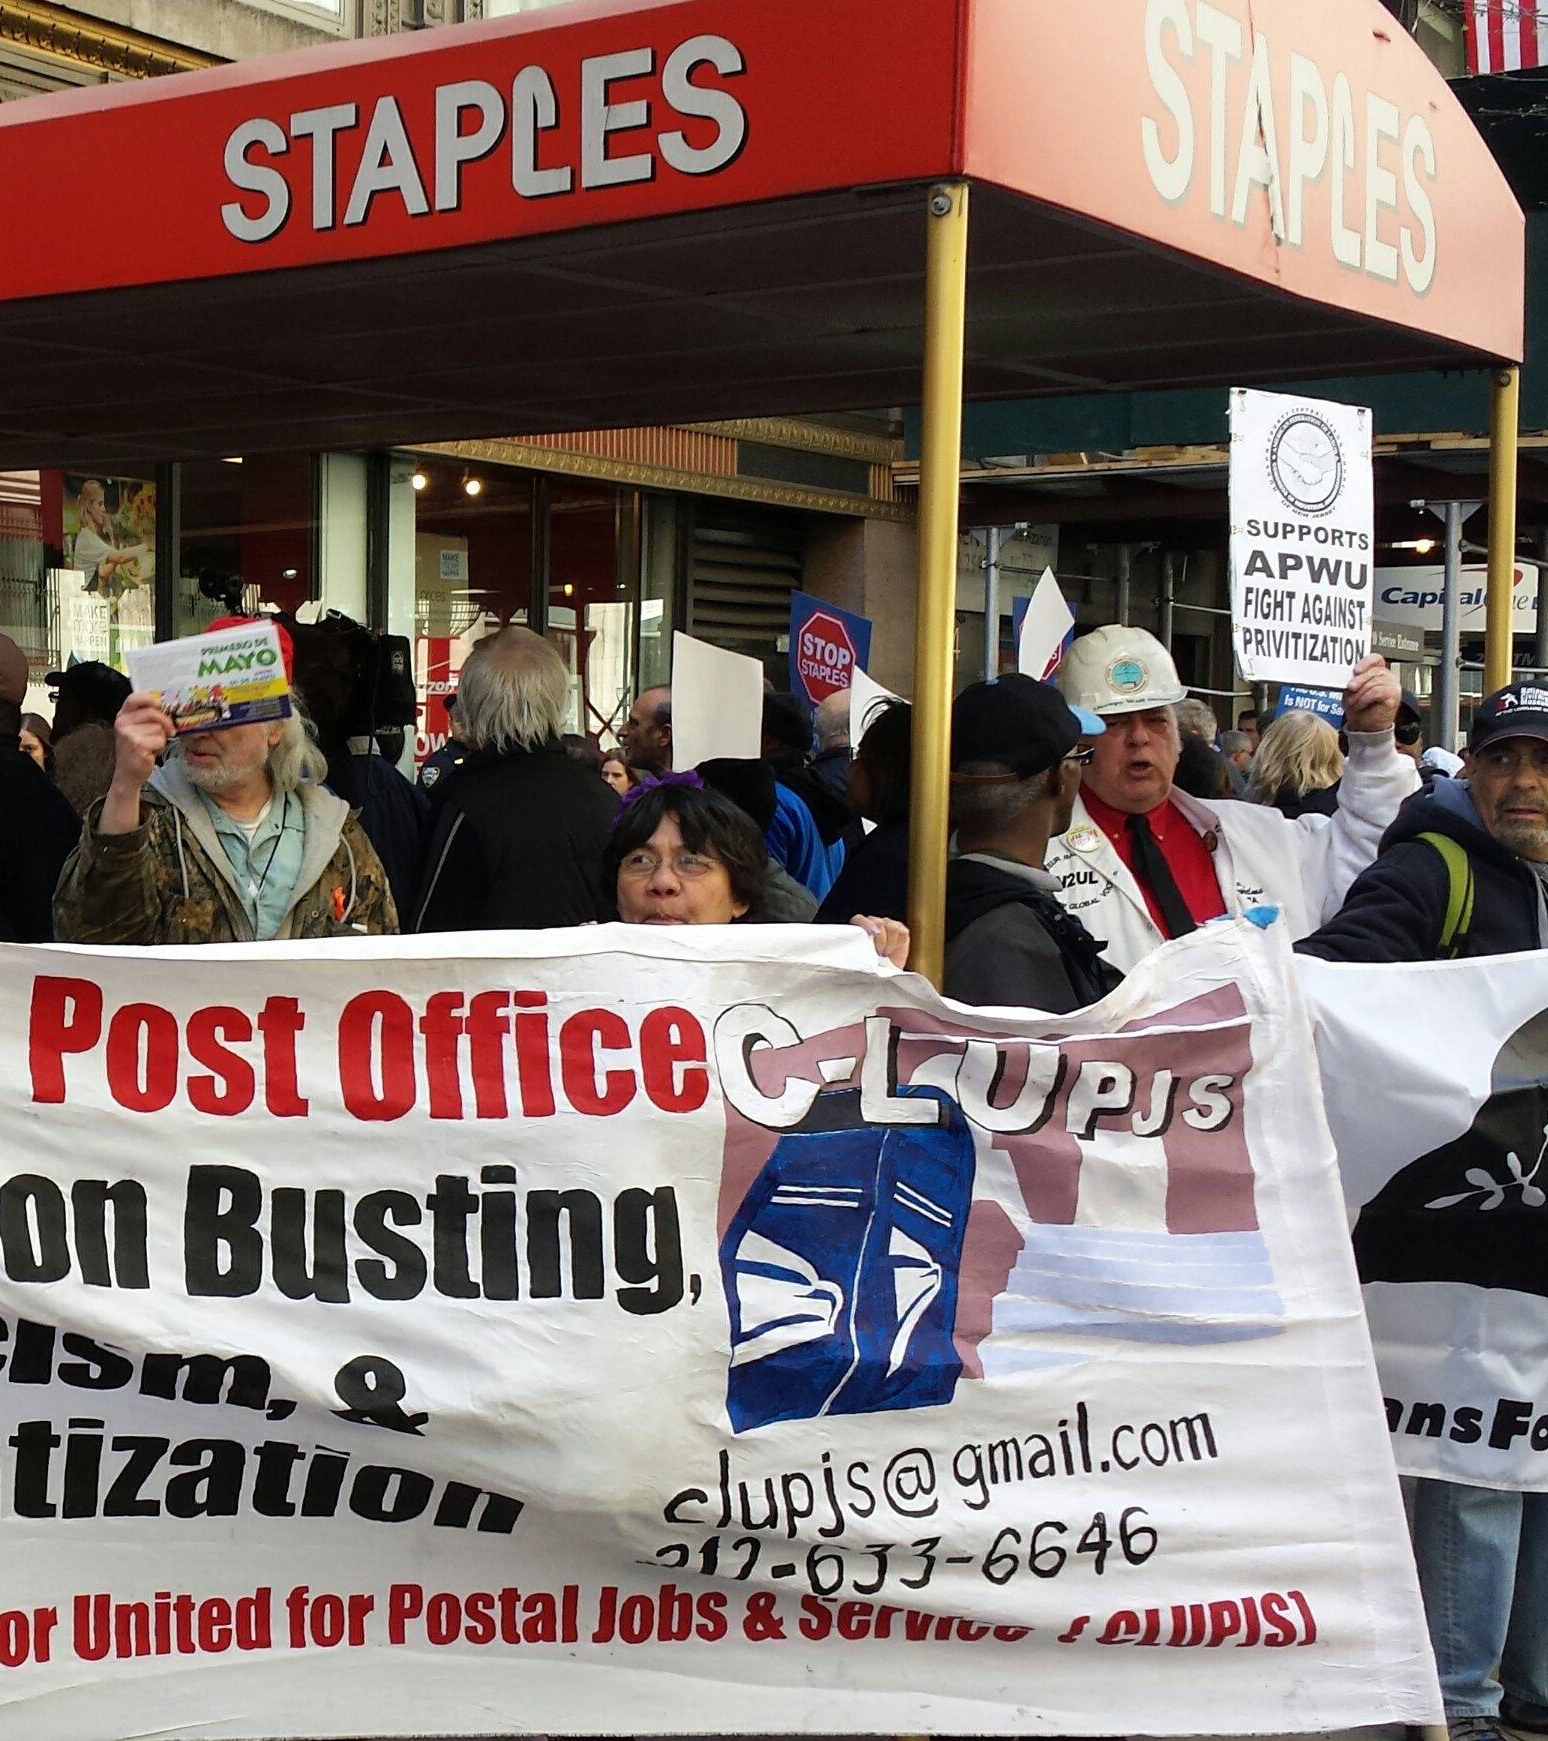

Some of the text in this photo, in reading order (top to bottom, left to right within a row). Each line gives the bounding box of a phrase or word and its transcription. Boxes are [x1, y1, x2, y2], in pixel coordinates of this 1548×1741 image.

[220, 34, 747, 243] STAPLES
[1140, 0, 1437, 294] STAPLES
[1246, 519, 1369, 550] SUPPORTS
[1243, 549, 1368, 590] APWU
[73, 604, 108, 620] MAKE
[1243, 586, 1366, 631] FIGHT AGAINST
[1381, 586, 1483, 608] Capial
[197, 648, 277, 676] MAYO
[803, 633, 851, 669] STOP
[1242, 626, 1365, 666] PRIVITIZATION
[802, 658, 848, 687] STAPLES
[1294, 696, 1316, 710] NOT
[1317, 701, 1331, 713] for
[29, 975, 309, 1118] Post
[338, 989, 710, 1122] Office
[184, 1164, 702, 1316] Busting,
[328, 1354, 430, 1437] &
[72, 1587, 273, 1662] United
[286, 1586, 374, 1649] for
[388, 1584, 579, 1646] Postal
[591, 1584, 728, 1645] Jobs
[743, 1591, 788, 1643] &
